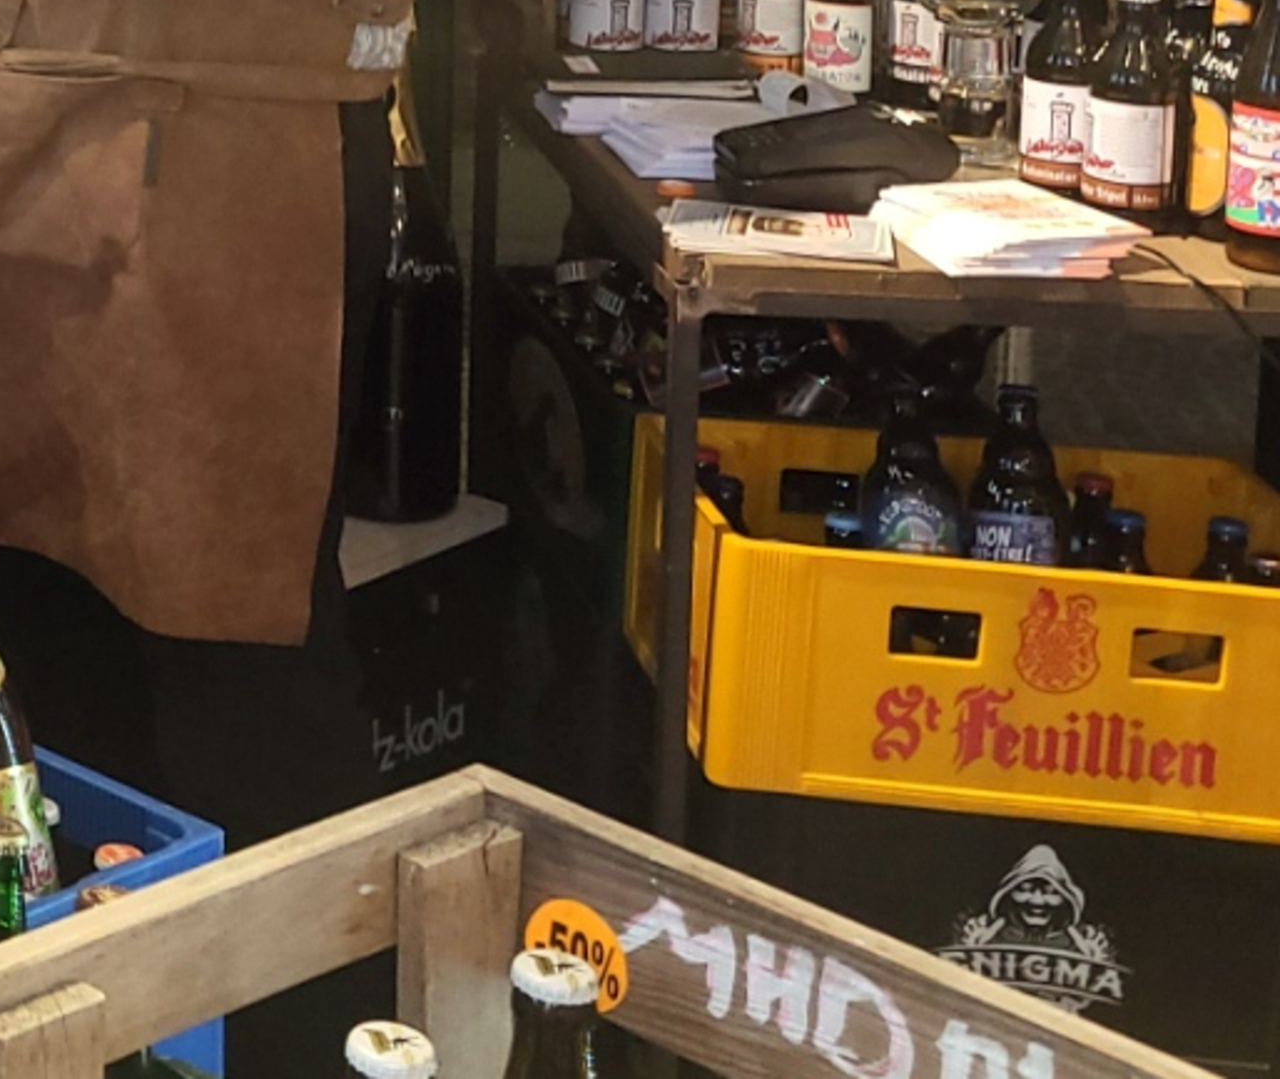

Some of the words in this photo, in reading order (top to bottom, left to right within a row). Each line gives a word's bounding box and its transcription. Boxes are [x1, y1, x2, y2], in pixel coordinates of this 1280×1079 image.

[870, 683, 942, 762] St
[953, 683, 1218, 789] Feuillien
[616, 896, 915, 1079] MHD
